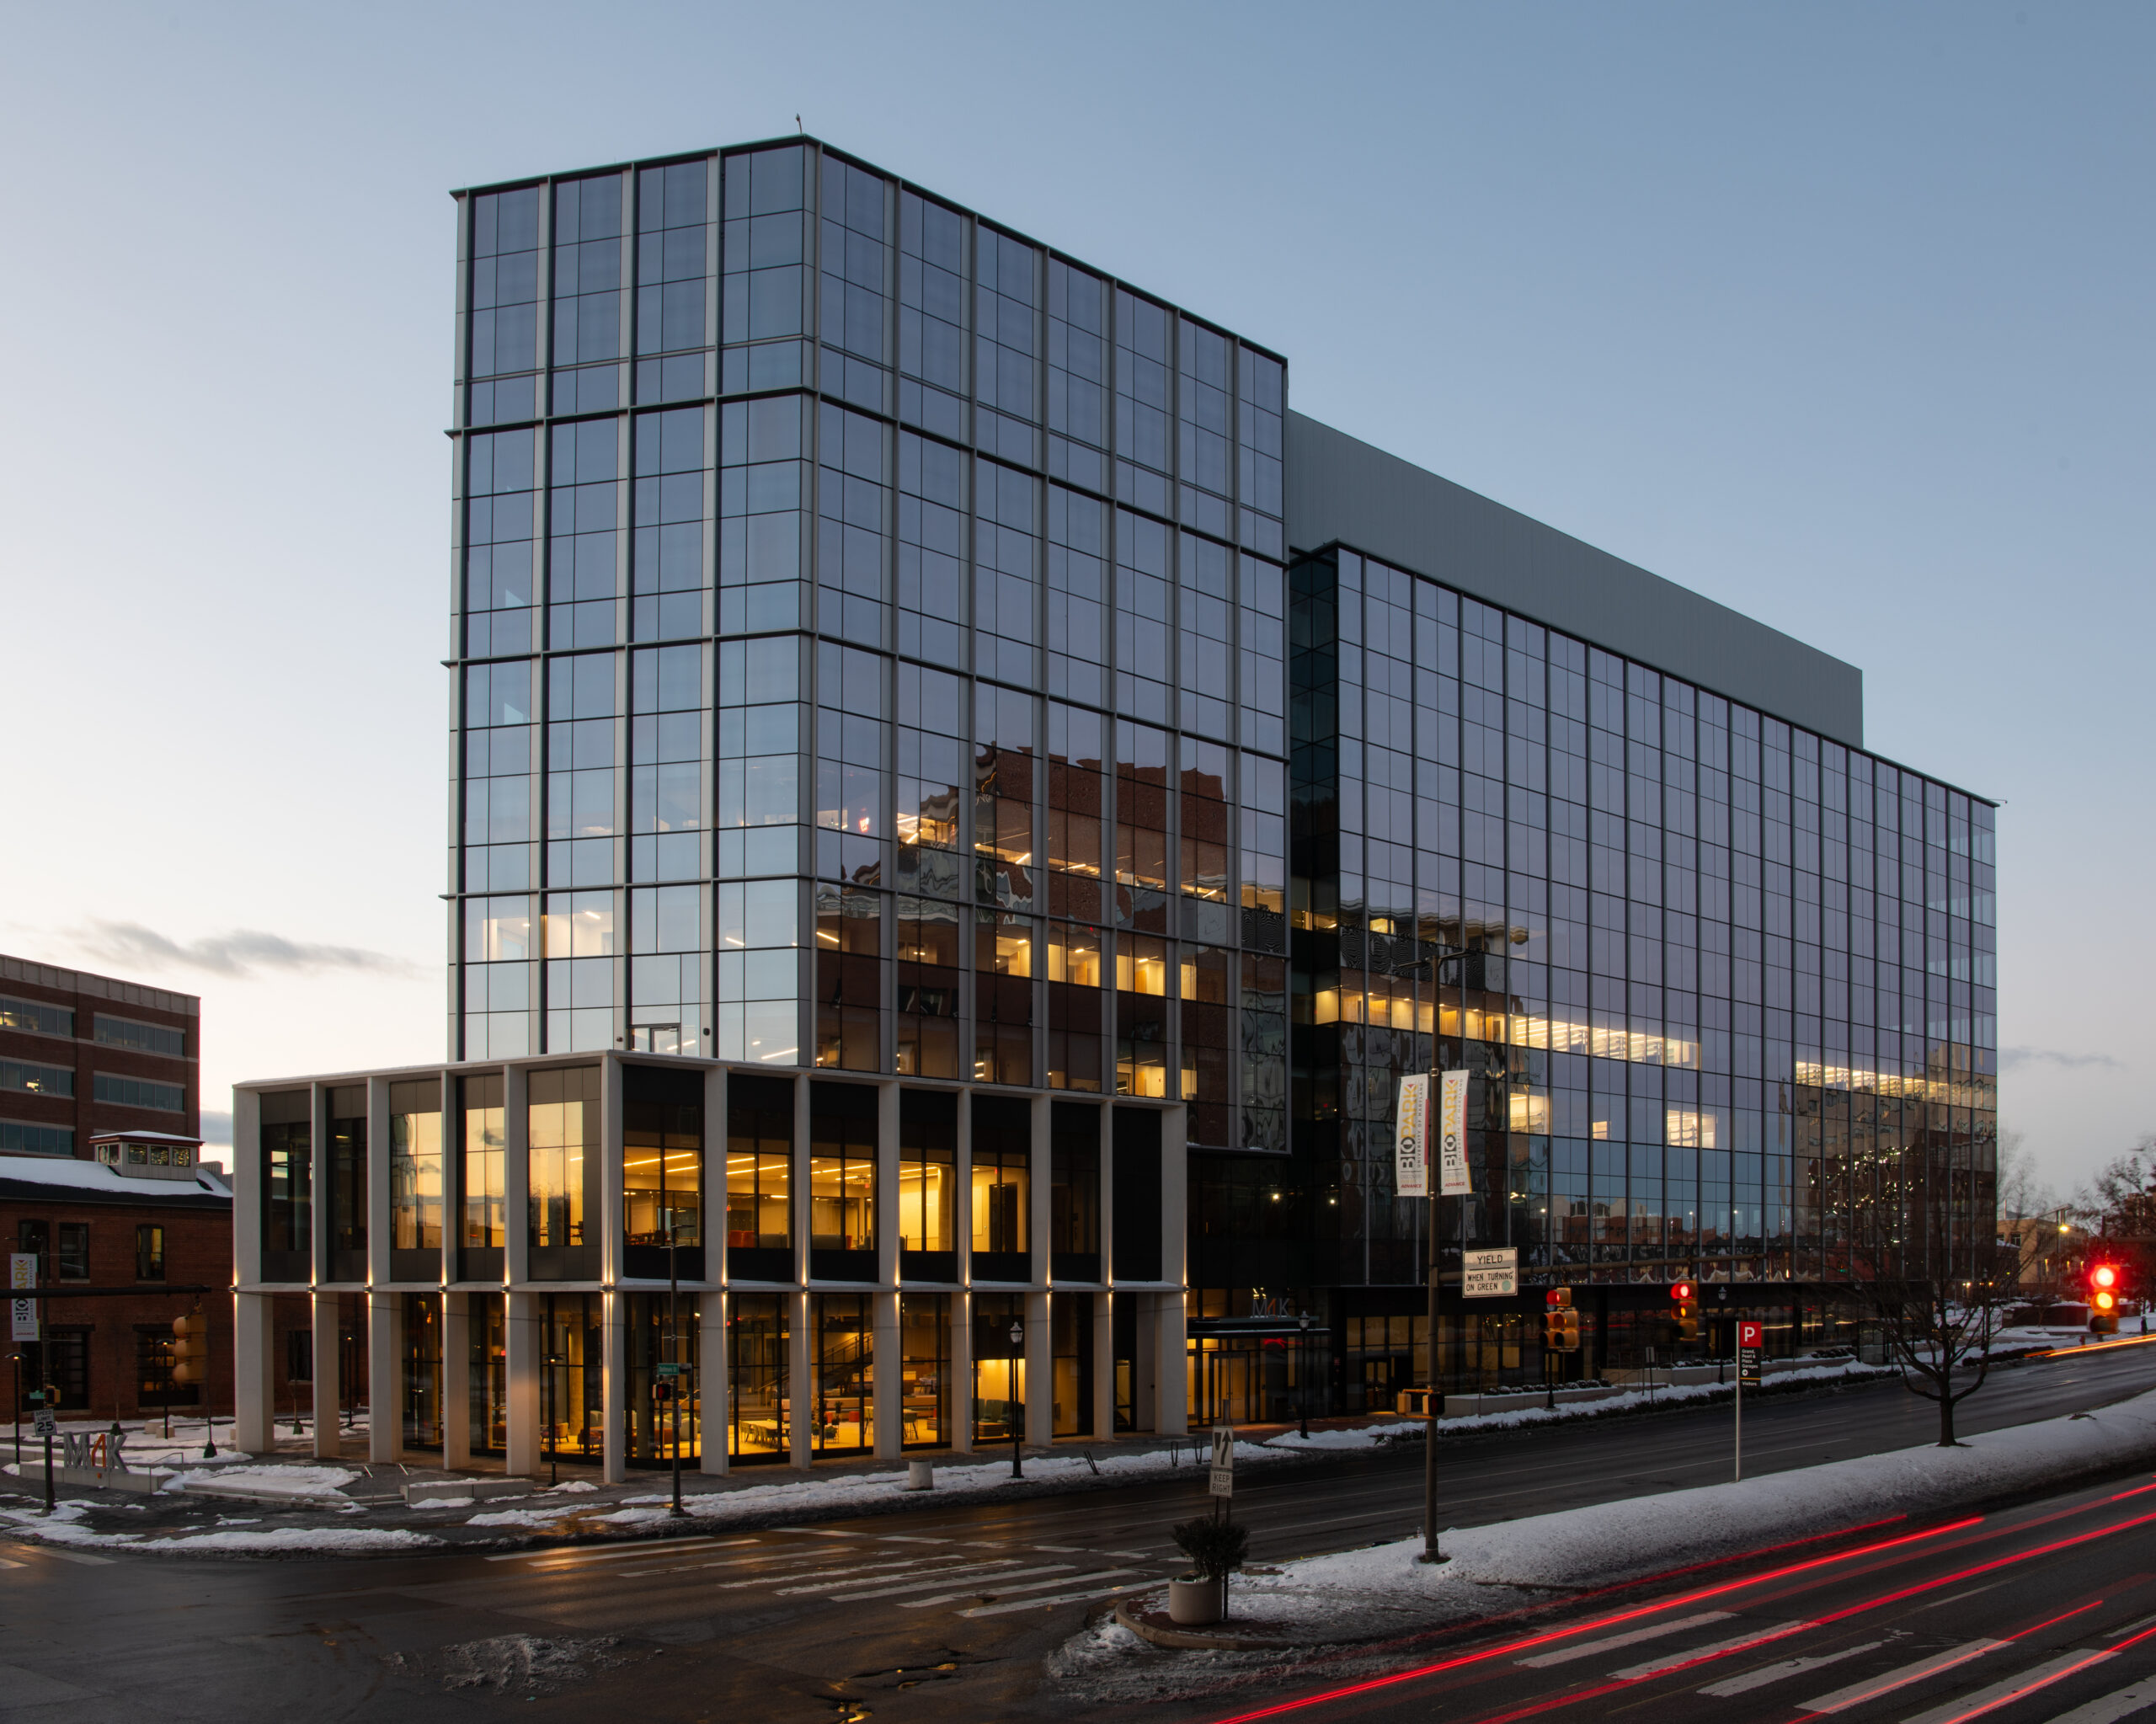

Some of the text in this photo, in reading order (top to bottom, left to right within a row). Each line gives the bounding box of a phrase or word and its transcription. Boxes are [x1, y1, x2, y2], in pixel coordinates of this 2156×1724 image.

[1400, 1083, 1418, 1168] BIOPARK
[1444, 1079, 1458, 1166] BIOPARK
[1477, 1254, 1502, 1265] YIELD
[1466, 1272, 1513, 1282] WHEN TURNING
[14, 1260, 29, 1321] BIOARK
[1466, 1282, 1498, 1292] ON GREEN
[1744, 1326, 1755, 1342] P
[37, 1421, 54, 1432] 25
[1214, 1473, 1230, 1482] KEEP
[1213, 1483, 1230, 1492] RIGHT
